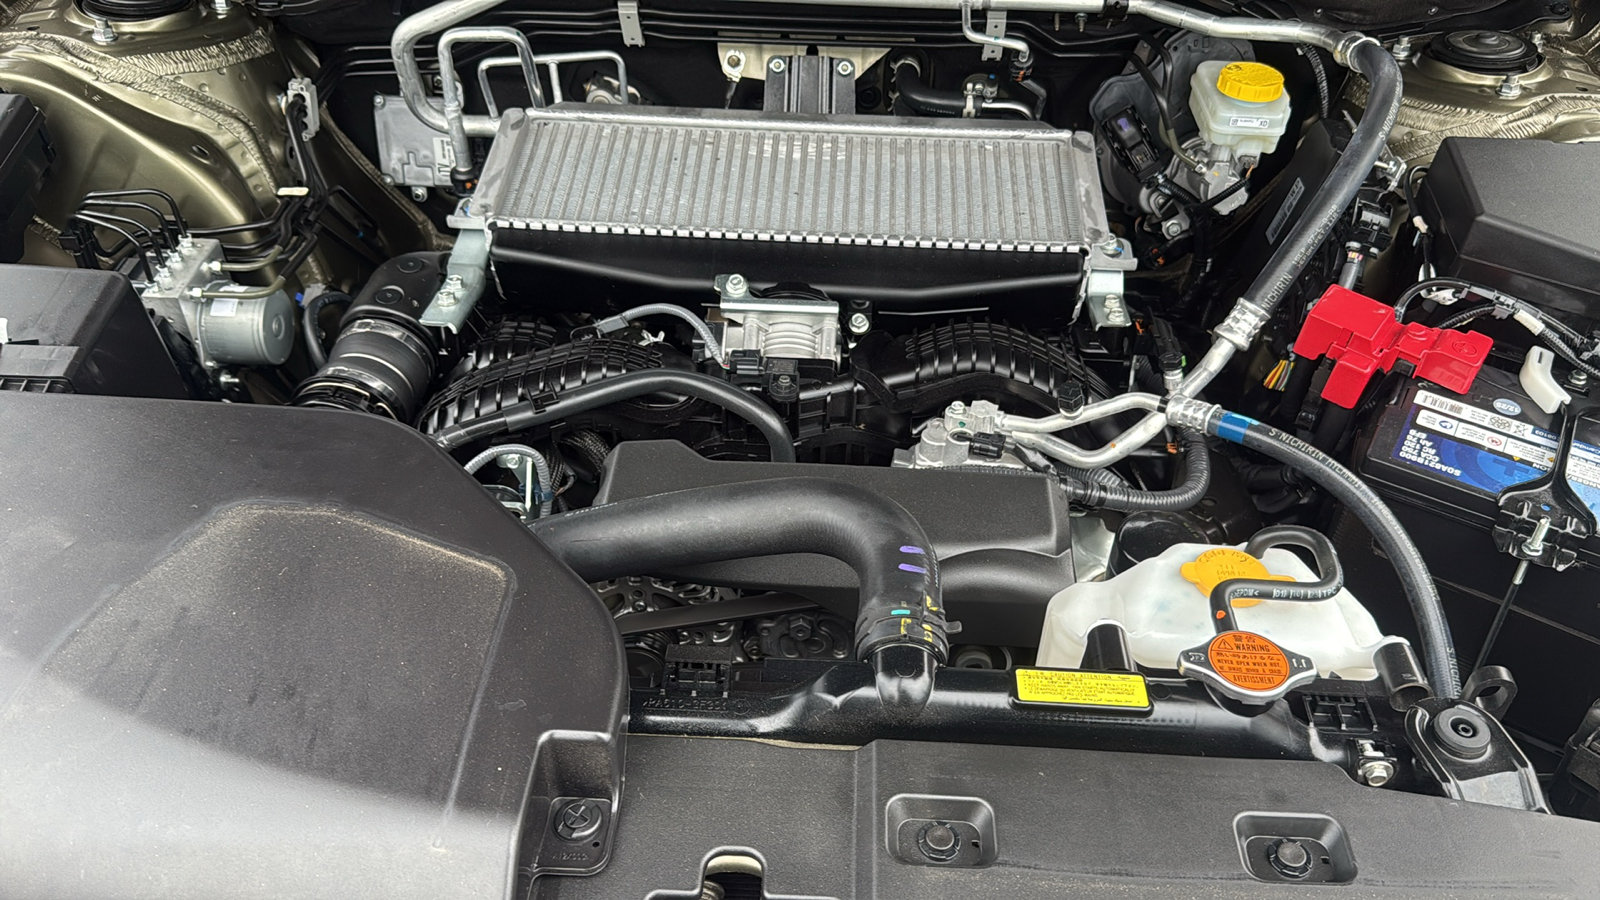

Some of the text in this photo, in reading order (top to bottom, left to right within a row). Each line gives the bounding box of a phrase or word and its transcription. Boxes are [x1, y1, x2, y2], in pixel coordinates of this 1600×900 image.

[1262, 272, 1293, 310] NICHIRIN
[1409, 429, 1427, 439] EFB
[1402, 445, 1439, 461] CCA 750
[1404, 440, 1436, 455] RC 120
[1234, 643, 1270, 652] WARNING
